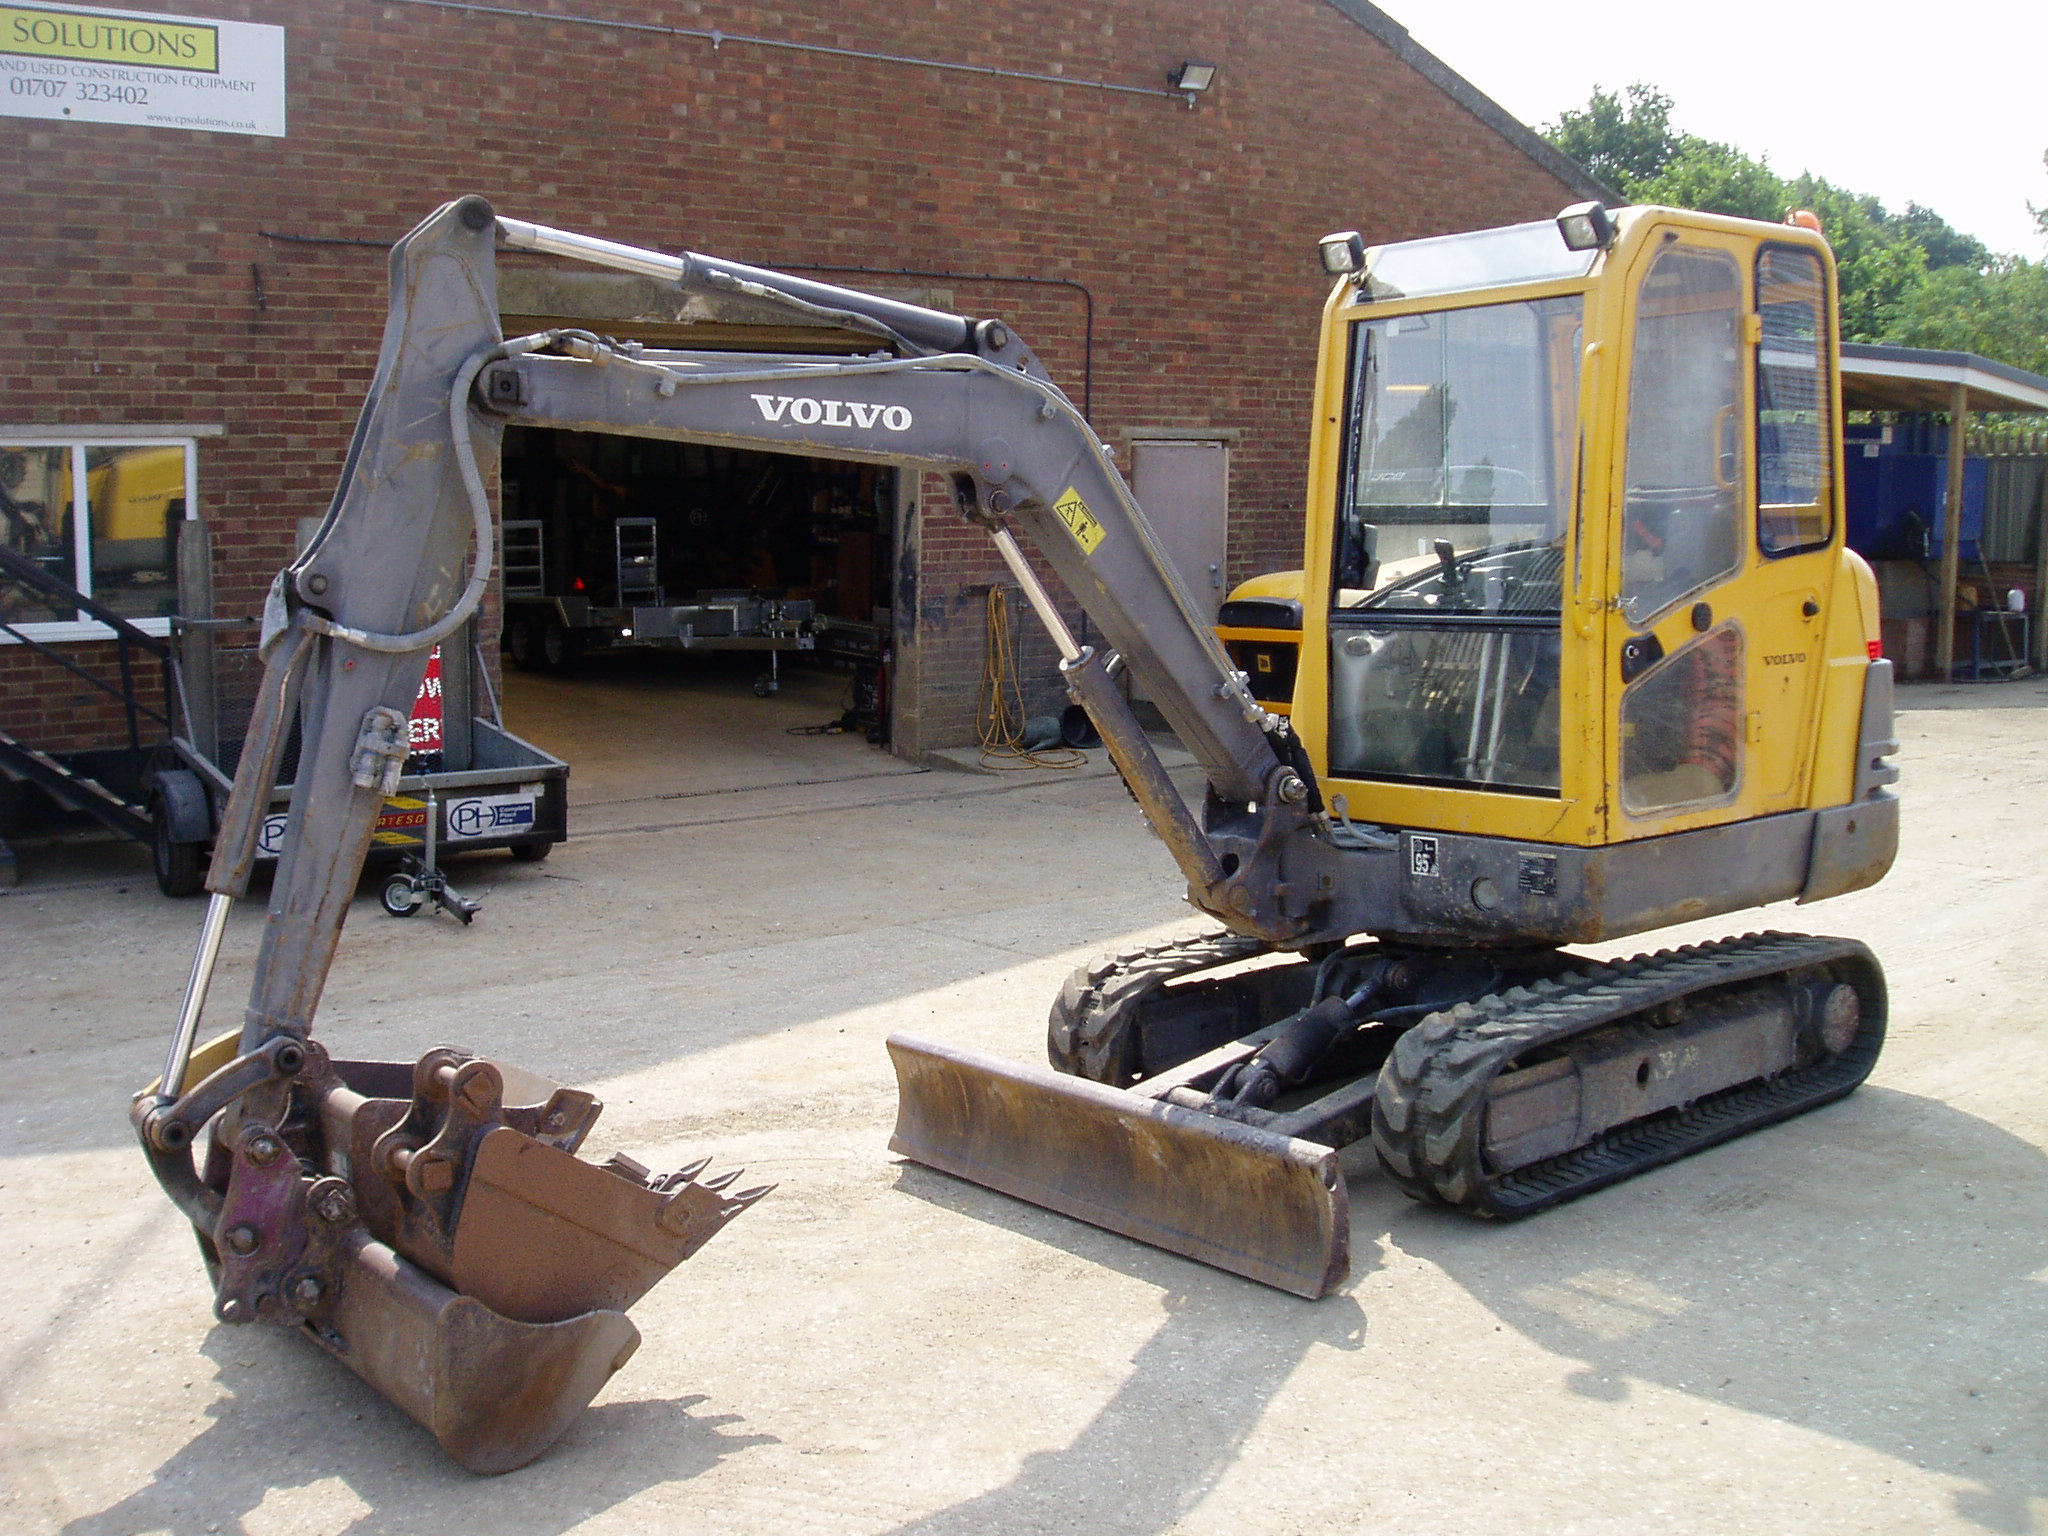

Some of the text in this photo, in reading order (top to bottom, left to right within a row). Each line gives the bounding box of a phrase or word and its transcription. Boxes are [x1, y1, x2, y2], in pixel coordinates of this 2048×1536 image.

[14, 17, 196, 58] SOLUTIONS
[10, 77, 149, 105] 01707 323402
[31, 62, 68, 76] USED
[71, 65, 178, 85] CONSTRUCTION
[182, 75, 257, 93] EQUIPMENT
[750, 394, 912, 431] VOLVO
[1763, 652, 1807, 665] VOLVO
[374, 814, 425, 827] ATESO
[1415, 853, 1430, 873] 95
